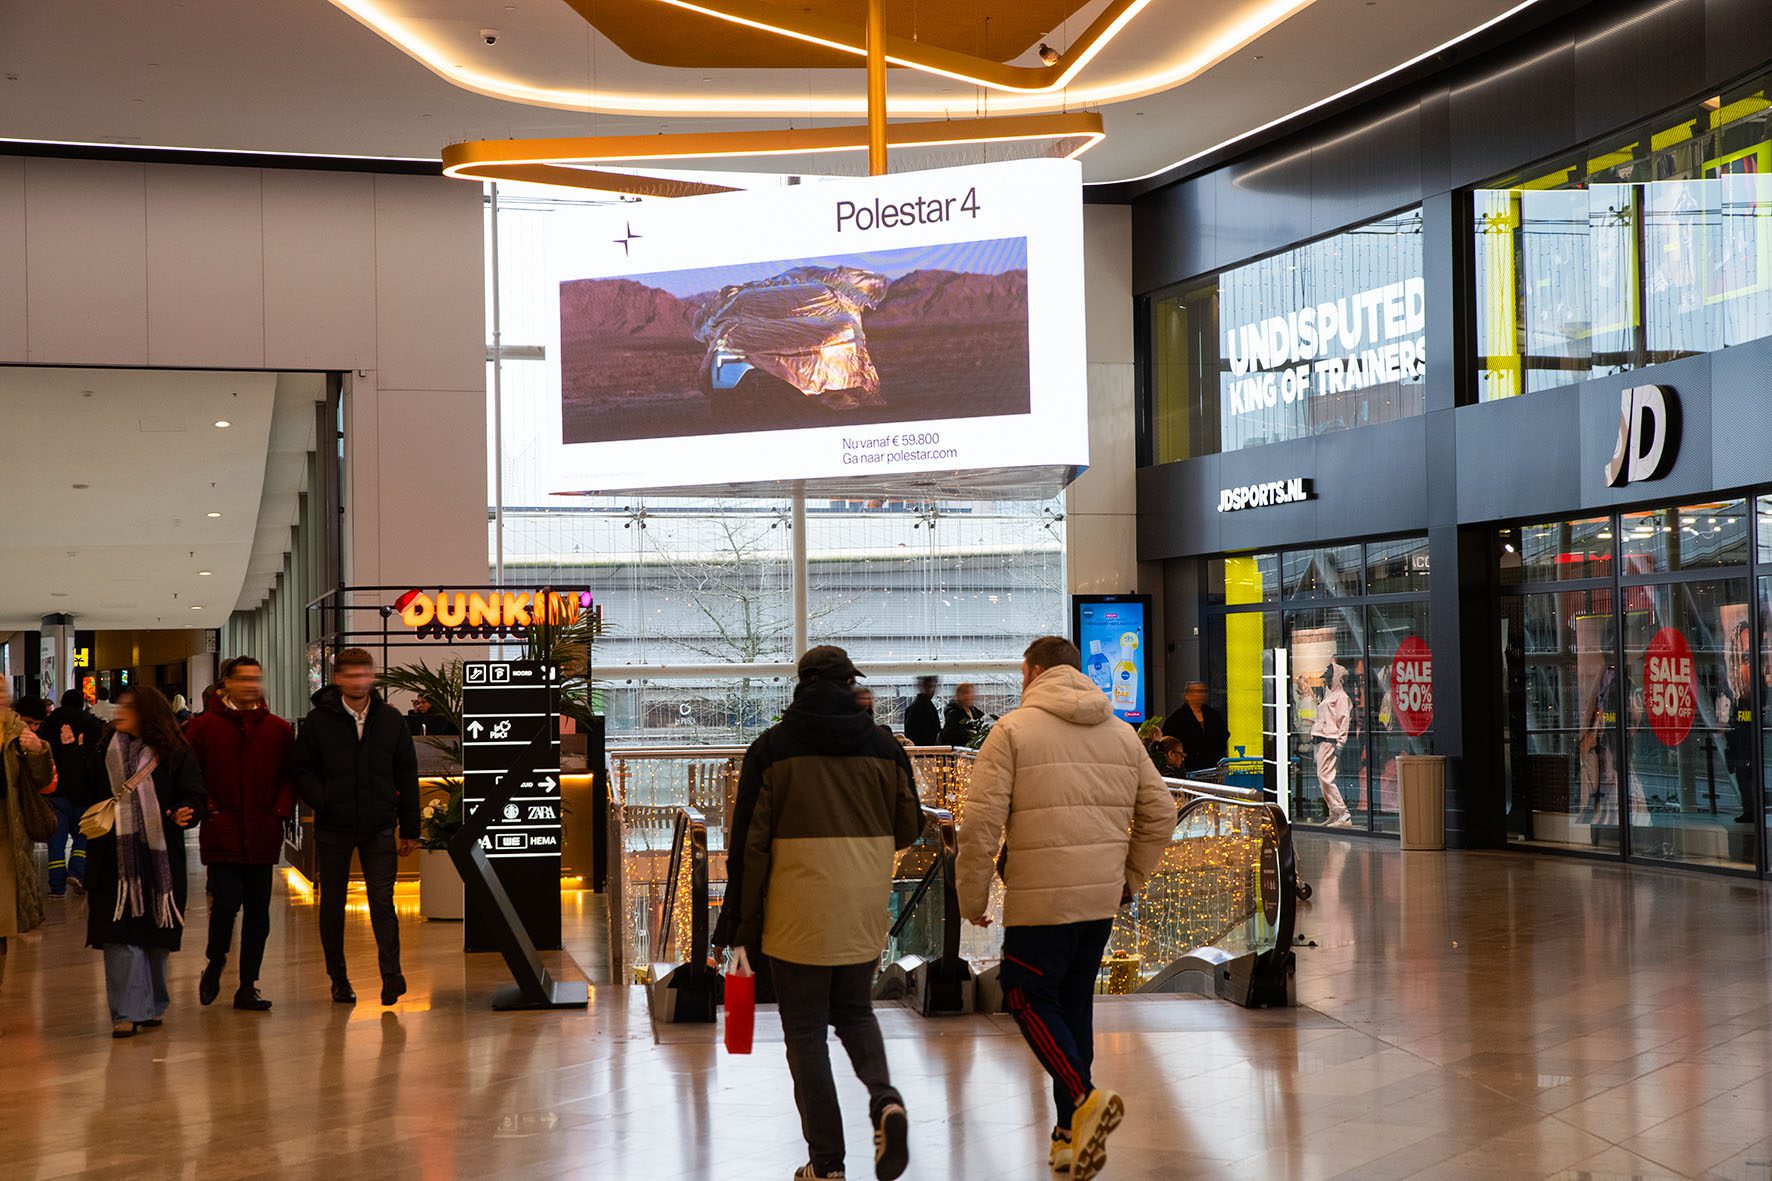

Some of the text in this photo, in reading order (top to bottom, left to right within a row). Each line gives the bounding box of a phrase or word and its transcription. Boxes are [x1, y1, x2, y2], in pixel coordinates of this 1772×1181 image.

[837, 186, 981, 233] Polestar 4
[1227, 276, 1425, 378] UNDISPUTED
[1229, 335, 1426, 416] KING OF TRAINERS
[842, 432, 940, 450] Nu vanaf € 59.800
[1604, 383, 1667, 488] JD
[842, 448, 958, 465] Ga naar polestar.com
[1217, 477, 1307, 513] JDSPORTS.NL
[1396, 660, 1432, 683] SALE
[1649, 656, 1691, 683] SALE
[1421, 703, 1433, 712] OFF
[1678, 707, 1693, 718] OFF
[528, 806, 556, 820] ZARA
[530, 836, 557, 846] HEMA
